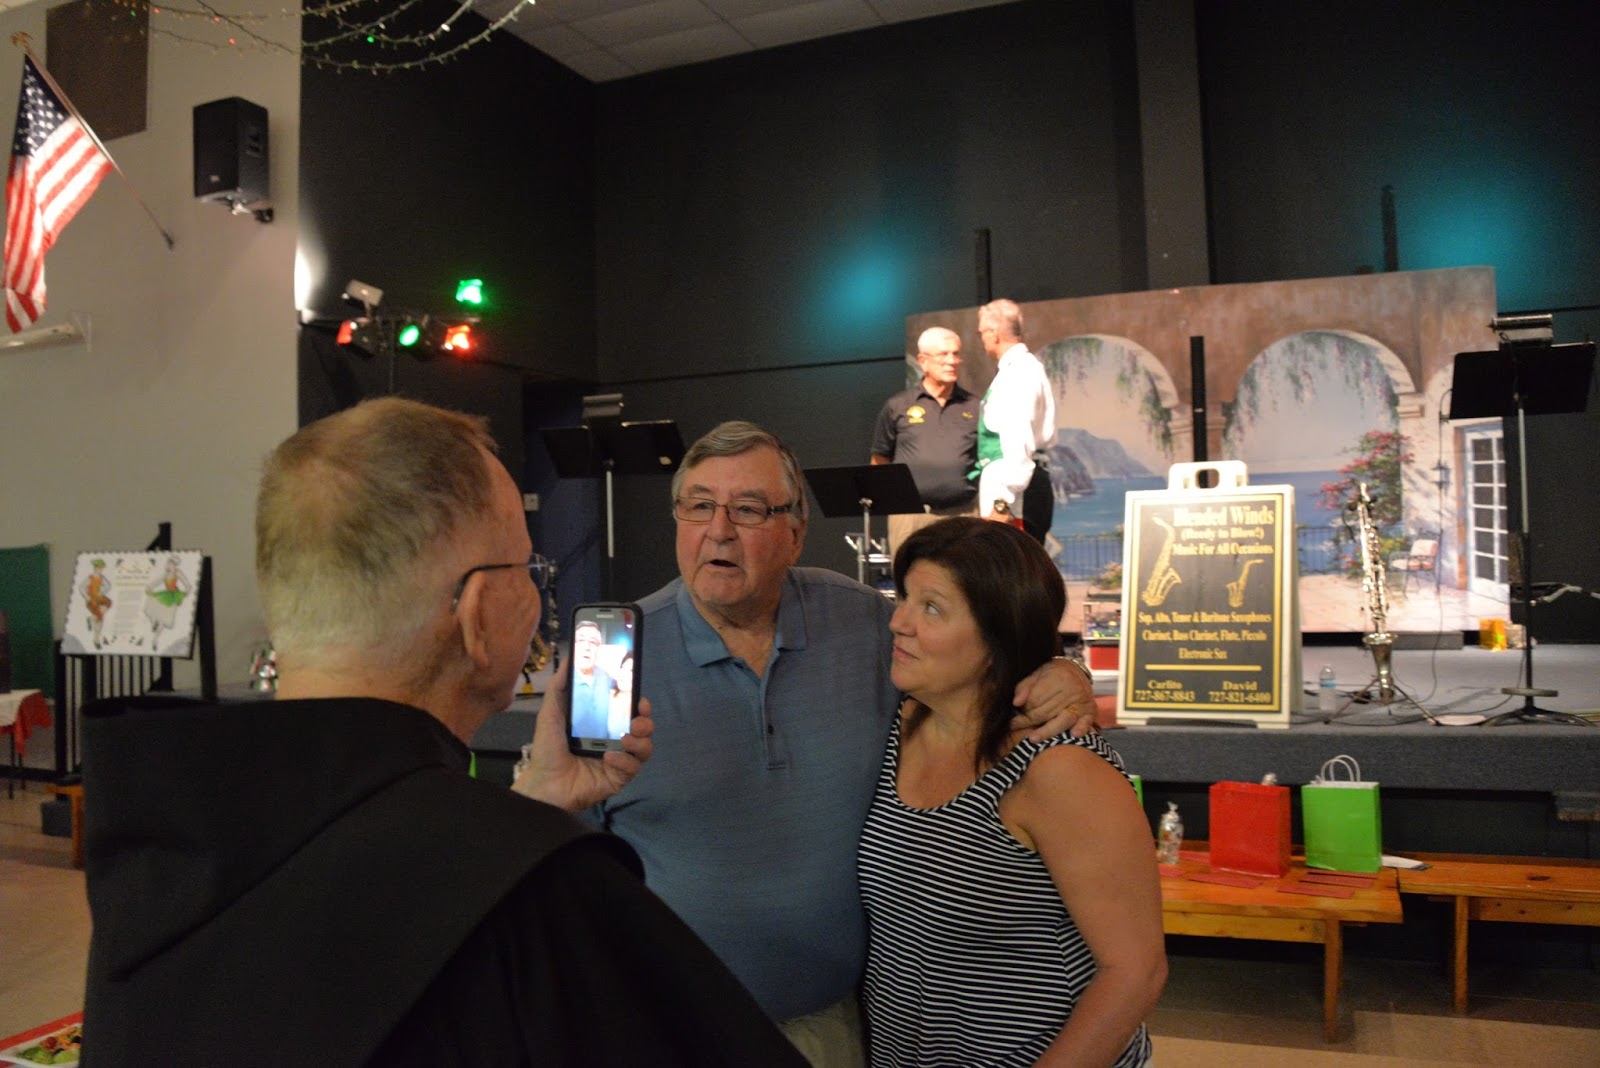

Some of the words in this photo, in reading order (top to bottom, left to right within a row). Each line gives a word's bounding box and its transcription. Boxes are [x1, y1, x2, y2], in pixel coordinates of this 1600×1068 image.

[1230, 505, 1274, 525] Winds
[1200, 542, 1215, 555] For
[1217, 542, 1230, 554] All
[1192, 612, 1200, 623] &
[1223, 681, 1258, 691] David
